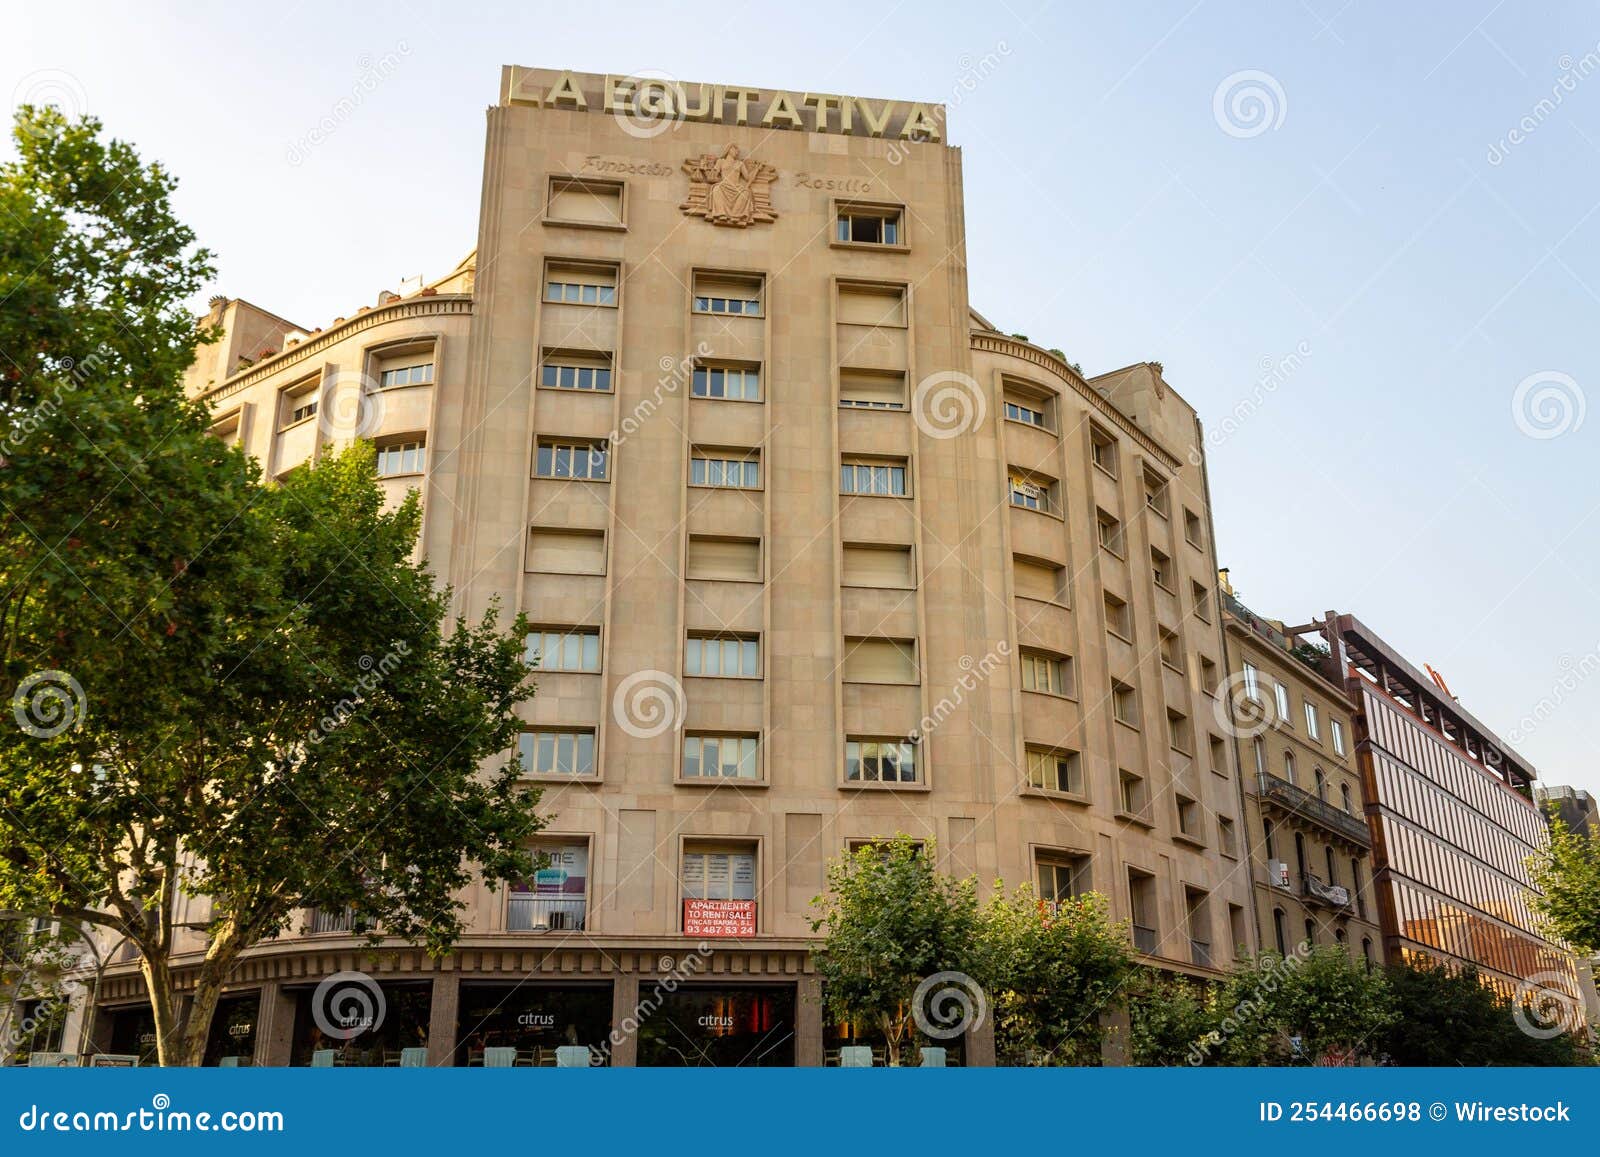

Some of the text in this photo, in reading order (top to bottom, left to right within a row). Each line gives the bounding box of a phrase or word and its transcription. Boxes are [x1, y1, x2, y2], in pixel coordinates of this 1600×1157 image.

[509, 63, 942, 143] LA EQUITATIVA
[691, 901, 750, 910] APARTMENTS
[688, 910, 752, 920] TO RENT/SALE
[702, 926, 722, 934] 487
[725, 926, 738, 934] 53
[740, 926, 753, 934] 24
[340, 1014, 373, 1027] citrus
[517, 1012, 555, 1025] citrus
[697, 1014, 734, 1026] citrus
[229, 1023, 251, 1036] citrus
